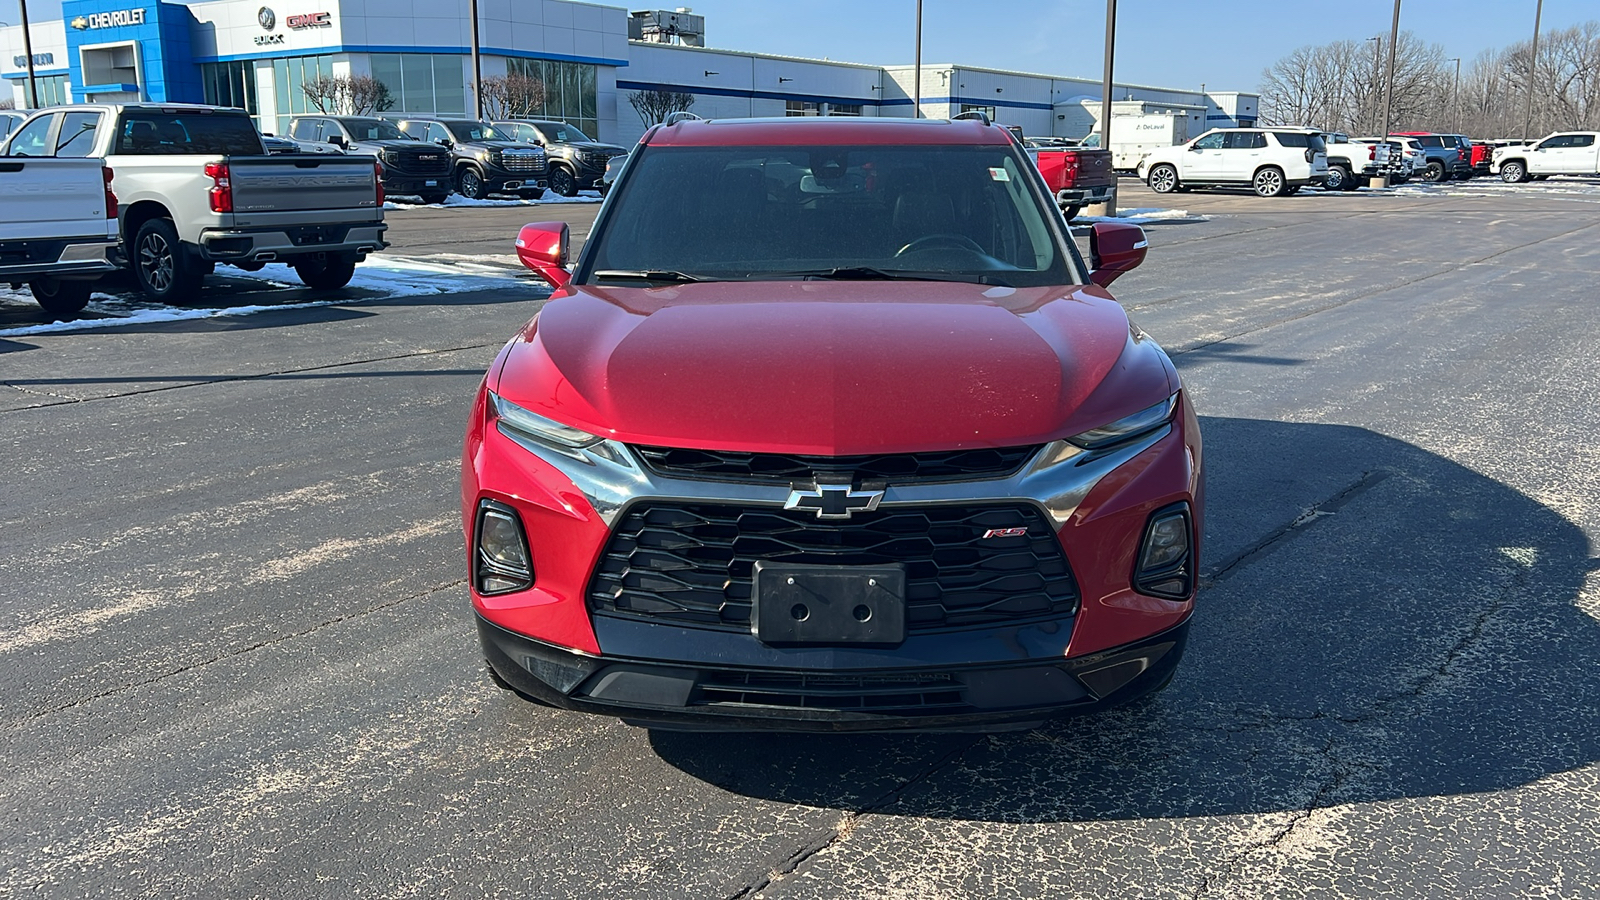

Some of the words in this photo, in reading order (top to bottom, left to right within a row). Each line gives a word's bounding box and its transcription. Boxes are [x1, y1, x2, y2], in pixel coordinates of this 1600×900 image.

[88, 8, 147, 30] CHEVROLET
[286, 12, 331, 30] GMC
[254, 34, 284, 46] BUICK
[982, 526, 1028, 538] RS
